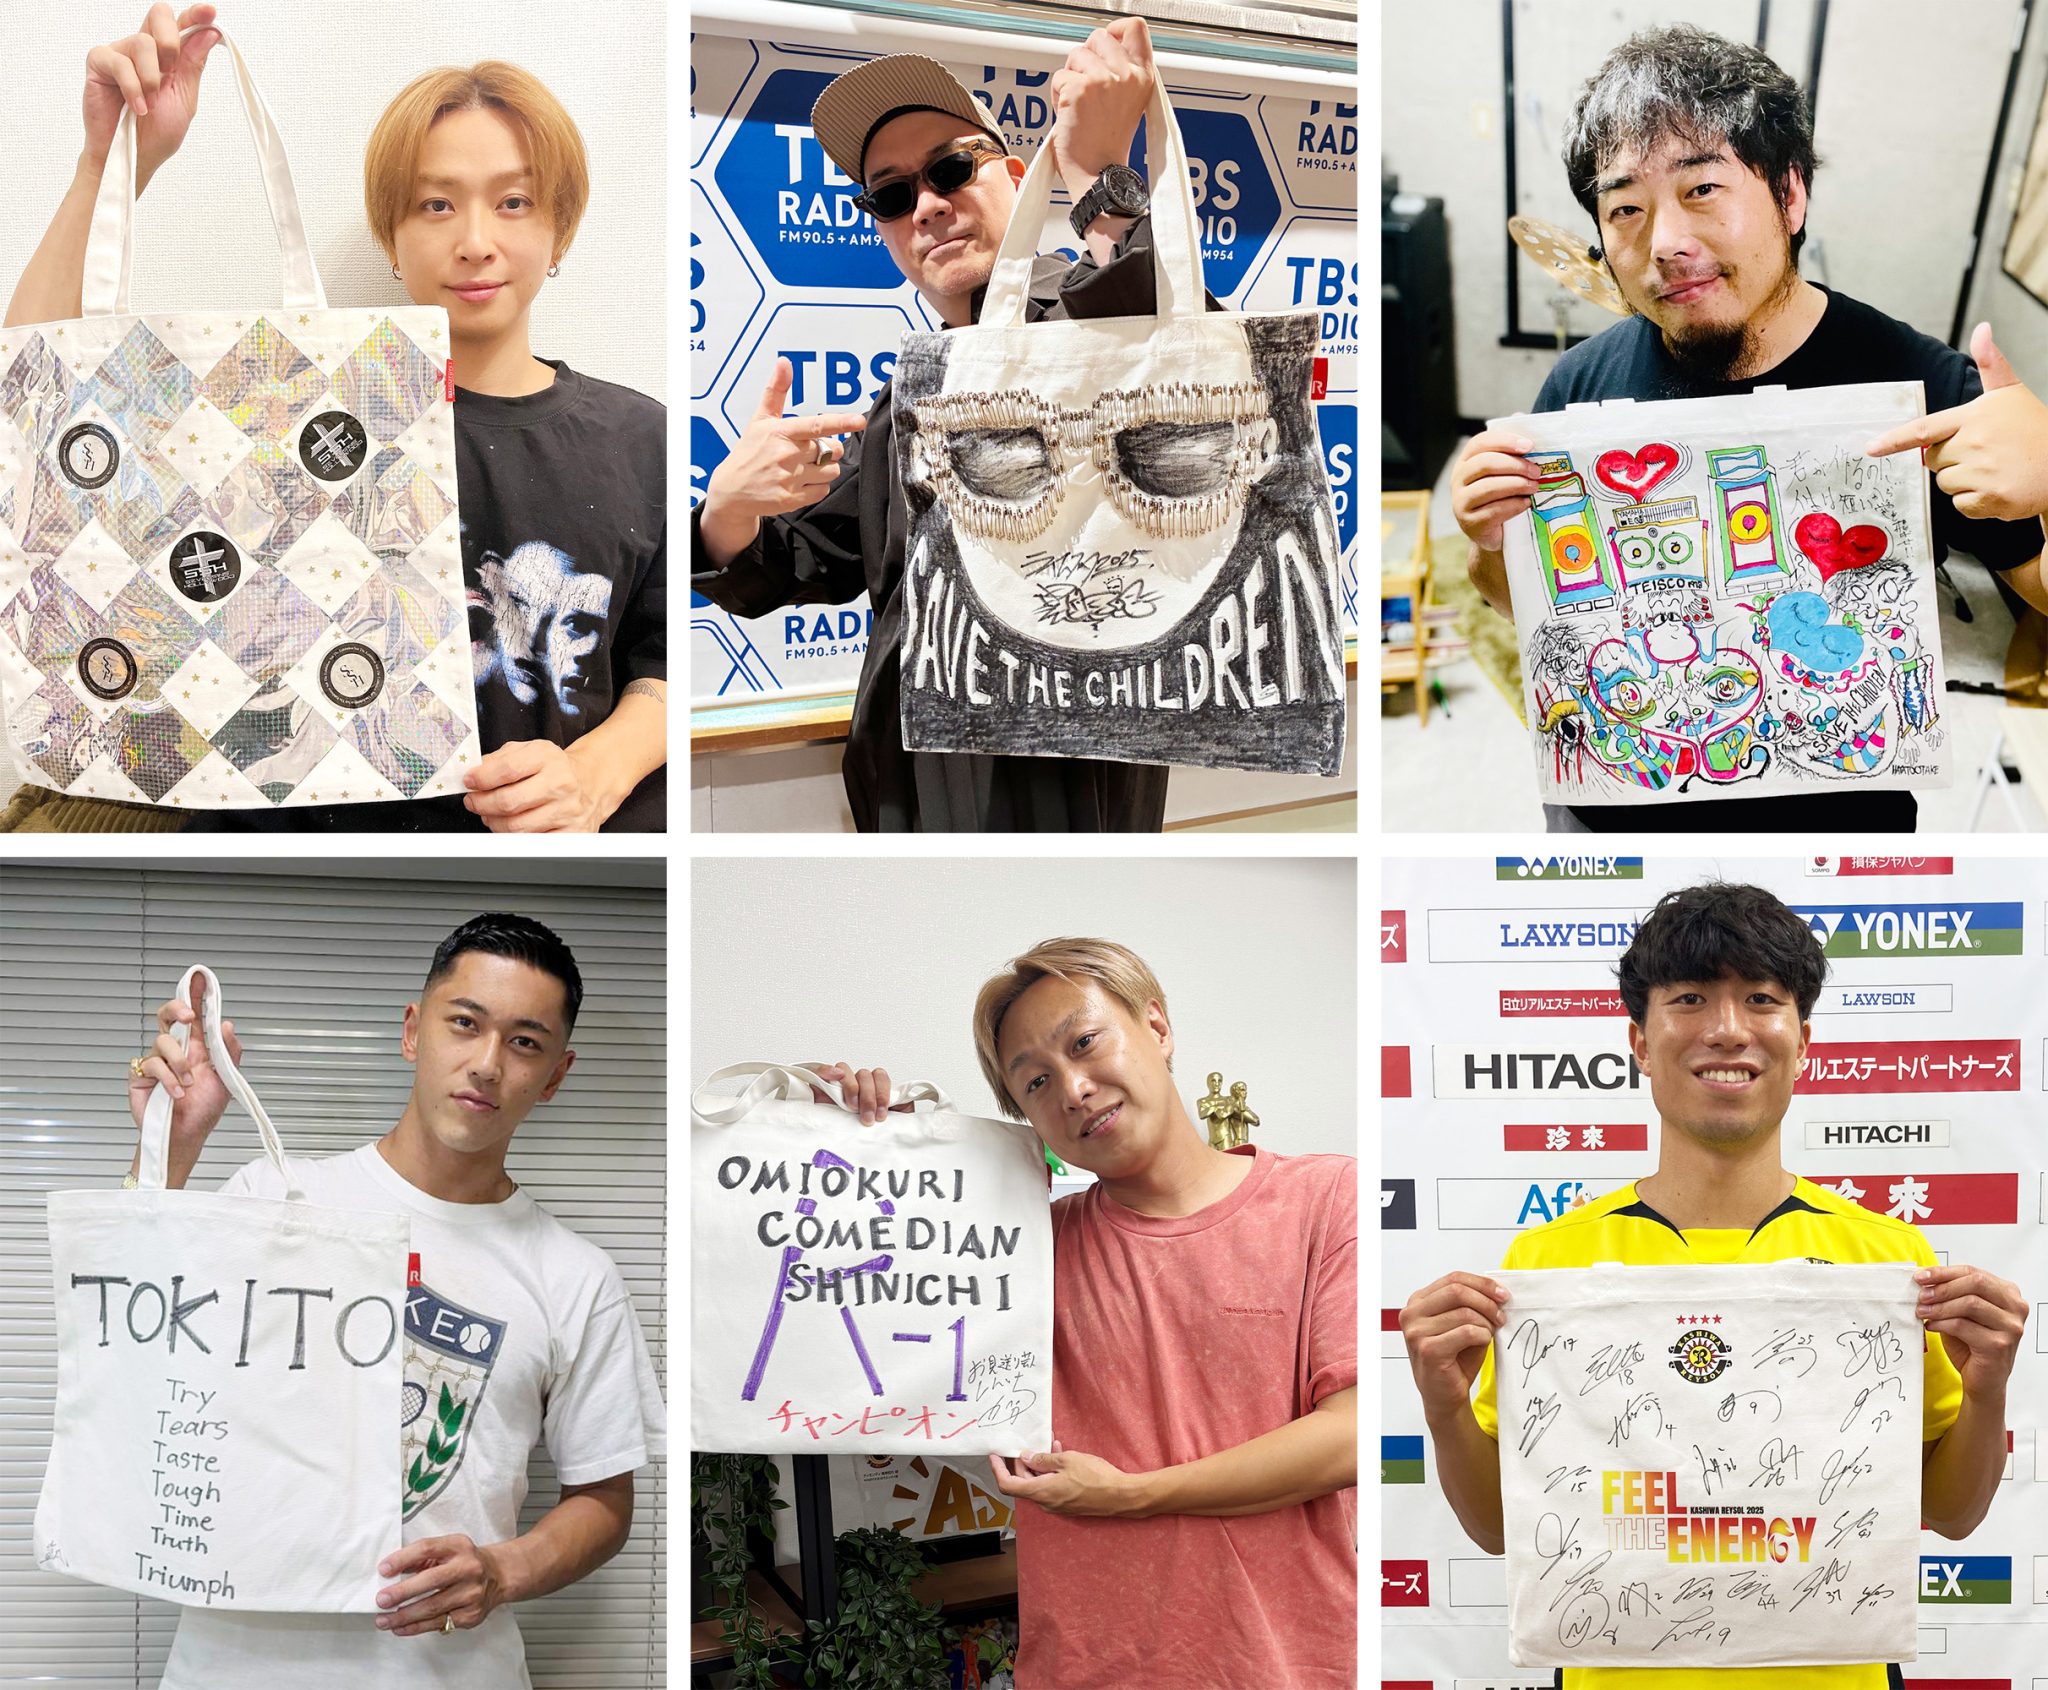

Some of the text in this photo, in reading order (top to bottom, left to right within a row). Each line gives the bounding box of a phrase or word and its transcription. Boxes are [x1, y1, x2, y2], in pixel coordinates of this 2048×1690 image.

[1628, 577, 1686, 595] TEISCO
[999, 650, 1073, 709] THE
[1085, 503, 1345, 712] CHILDREN
[1813, 720, 1849, 753] SAVE
[1556, 857, 1619, 876] YONEX
[1853, 911, 1974, 950] YONEX
[1842, 993, 1916, 1006] LAWSON
[1824, 1125, 1931, 1144] HITACHI
[717, 1155, 965, 1203] OMIOKURI
[757, 1211, 1022, 1260] COMEDIAN
[71, 1274, 398, 1371] TOKITO
[1677, 1330, 1722, 1348] KASHIWA
[1680, 1369, 1722, 1383] REYSOL
[166, 1378, 217, 1414] Try
[157, 1410, 229, 1441] Tears
[767, 1400, 978, 1441] チャンピオン
[153, 1440, 221, 1474] Taste
[152, 1469, 221, 1508] Tough
[1602, 1471, 1687, 1514] FEEL
[160, 1503, 216, 1533] Time
[1690, 1506, 1764, 1515] KASHIWA REYSOL 2025
[151, 1526, 209, 1555] Truth
[1603, 1518, 1666, 1550] THE
[1667, 1517, 1818, 1564] ENERGY
[135, 1552, 236, 1605] Triumph
